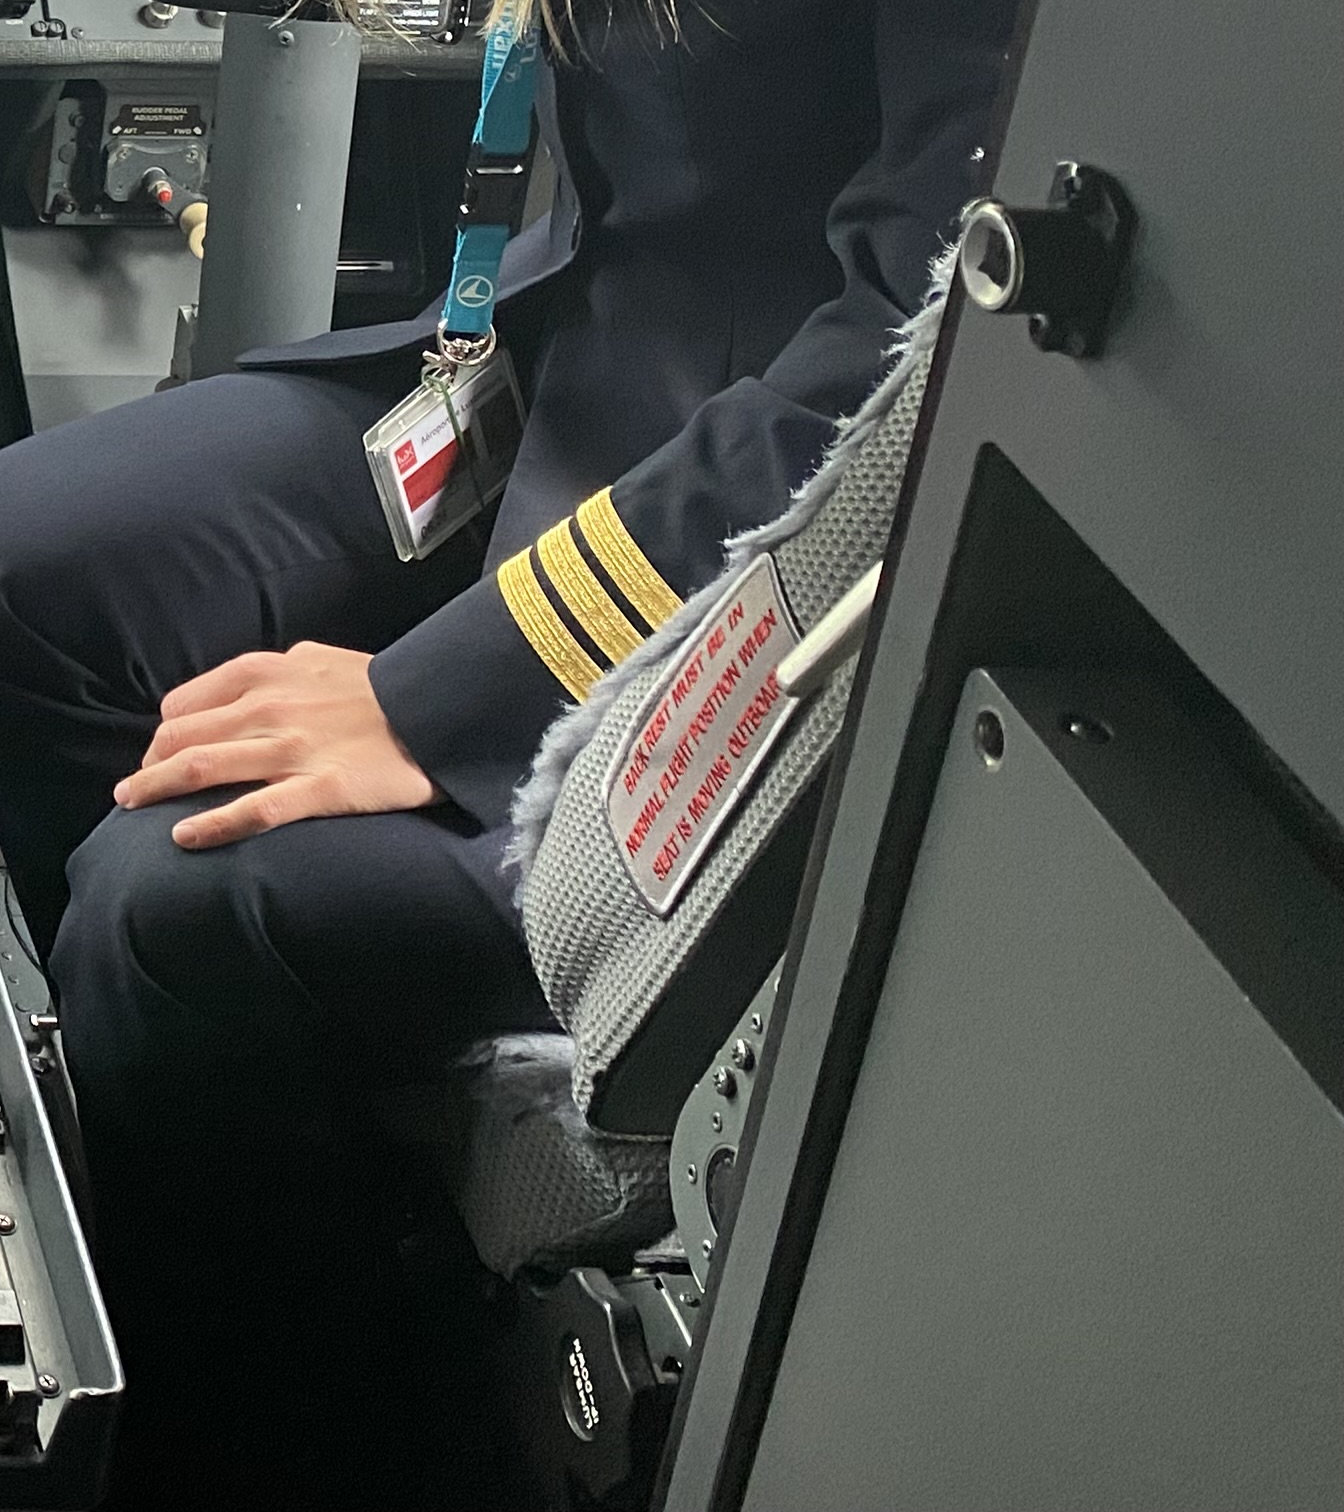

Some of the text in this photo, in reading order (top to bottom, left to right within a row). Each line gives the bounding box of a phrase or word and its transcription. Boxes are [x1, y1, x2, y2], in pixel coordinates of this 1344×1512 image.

[626, 609, 777, 859] NORMAL FLIGHT POSITION WHEN
[672, 653, 707, 708] MUST
[729, 602, 744, 632] IN
[653, 667, 782, 881] SEAT IS MOVING OUTBOAR
